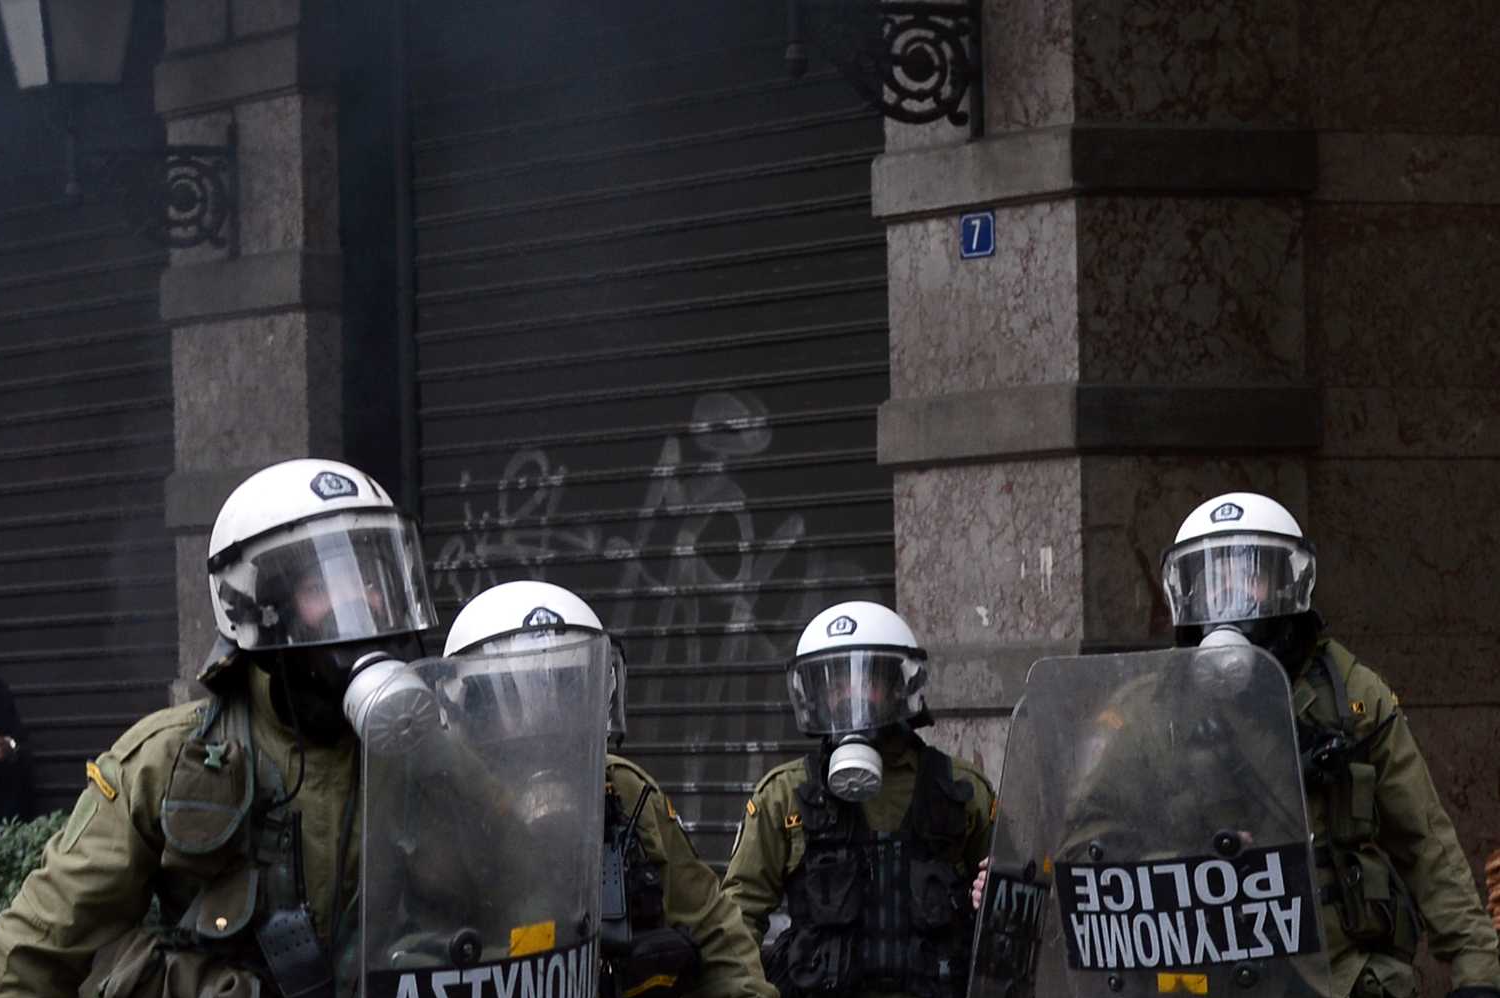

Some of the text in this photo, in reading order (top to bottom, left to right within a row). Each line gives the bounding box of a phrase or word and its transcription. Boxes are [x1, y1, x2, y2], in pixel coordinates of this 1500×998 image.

[971, 219, 981, 250] 7
[1070, 851, 1286, 913] POLICE
[1070, 896, 1301, 969] ΑΣΤΥΝΟΜΙΑ
